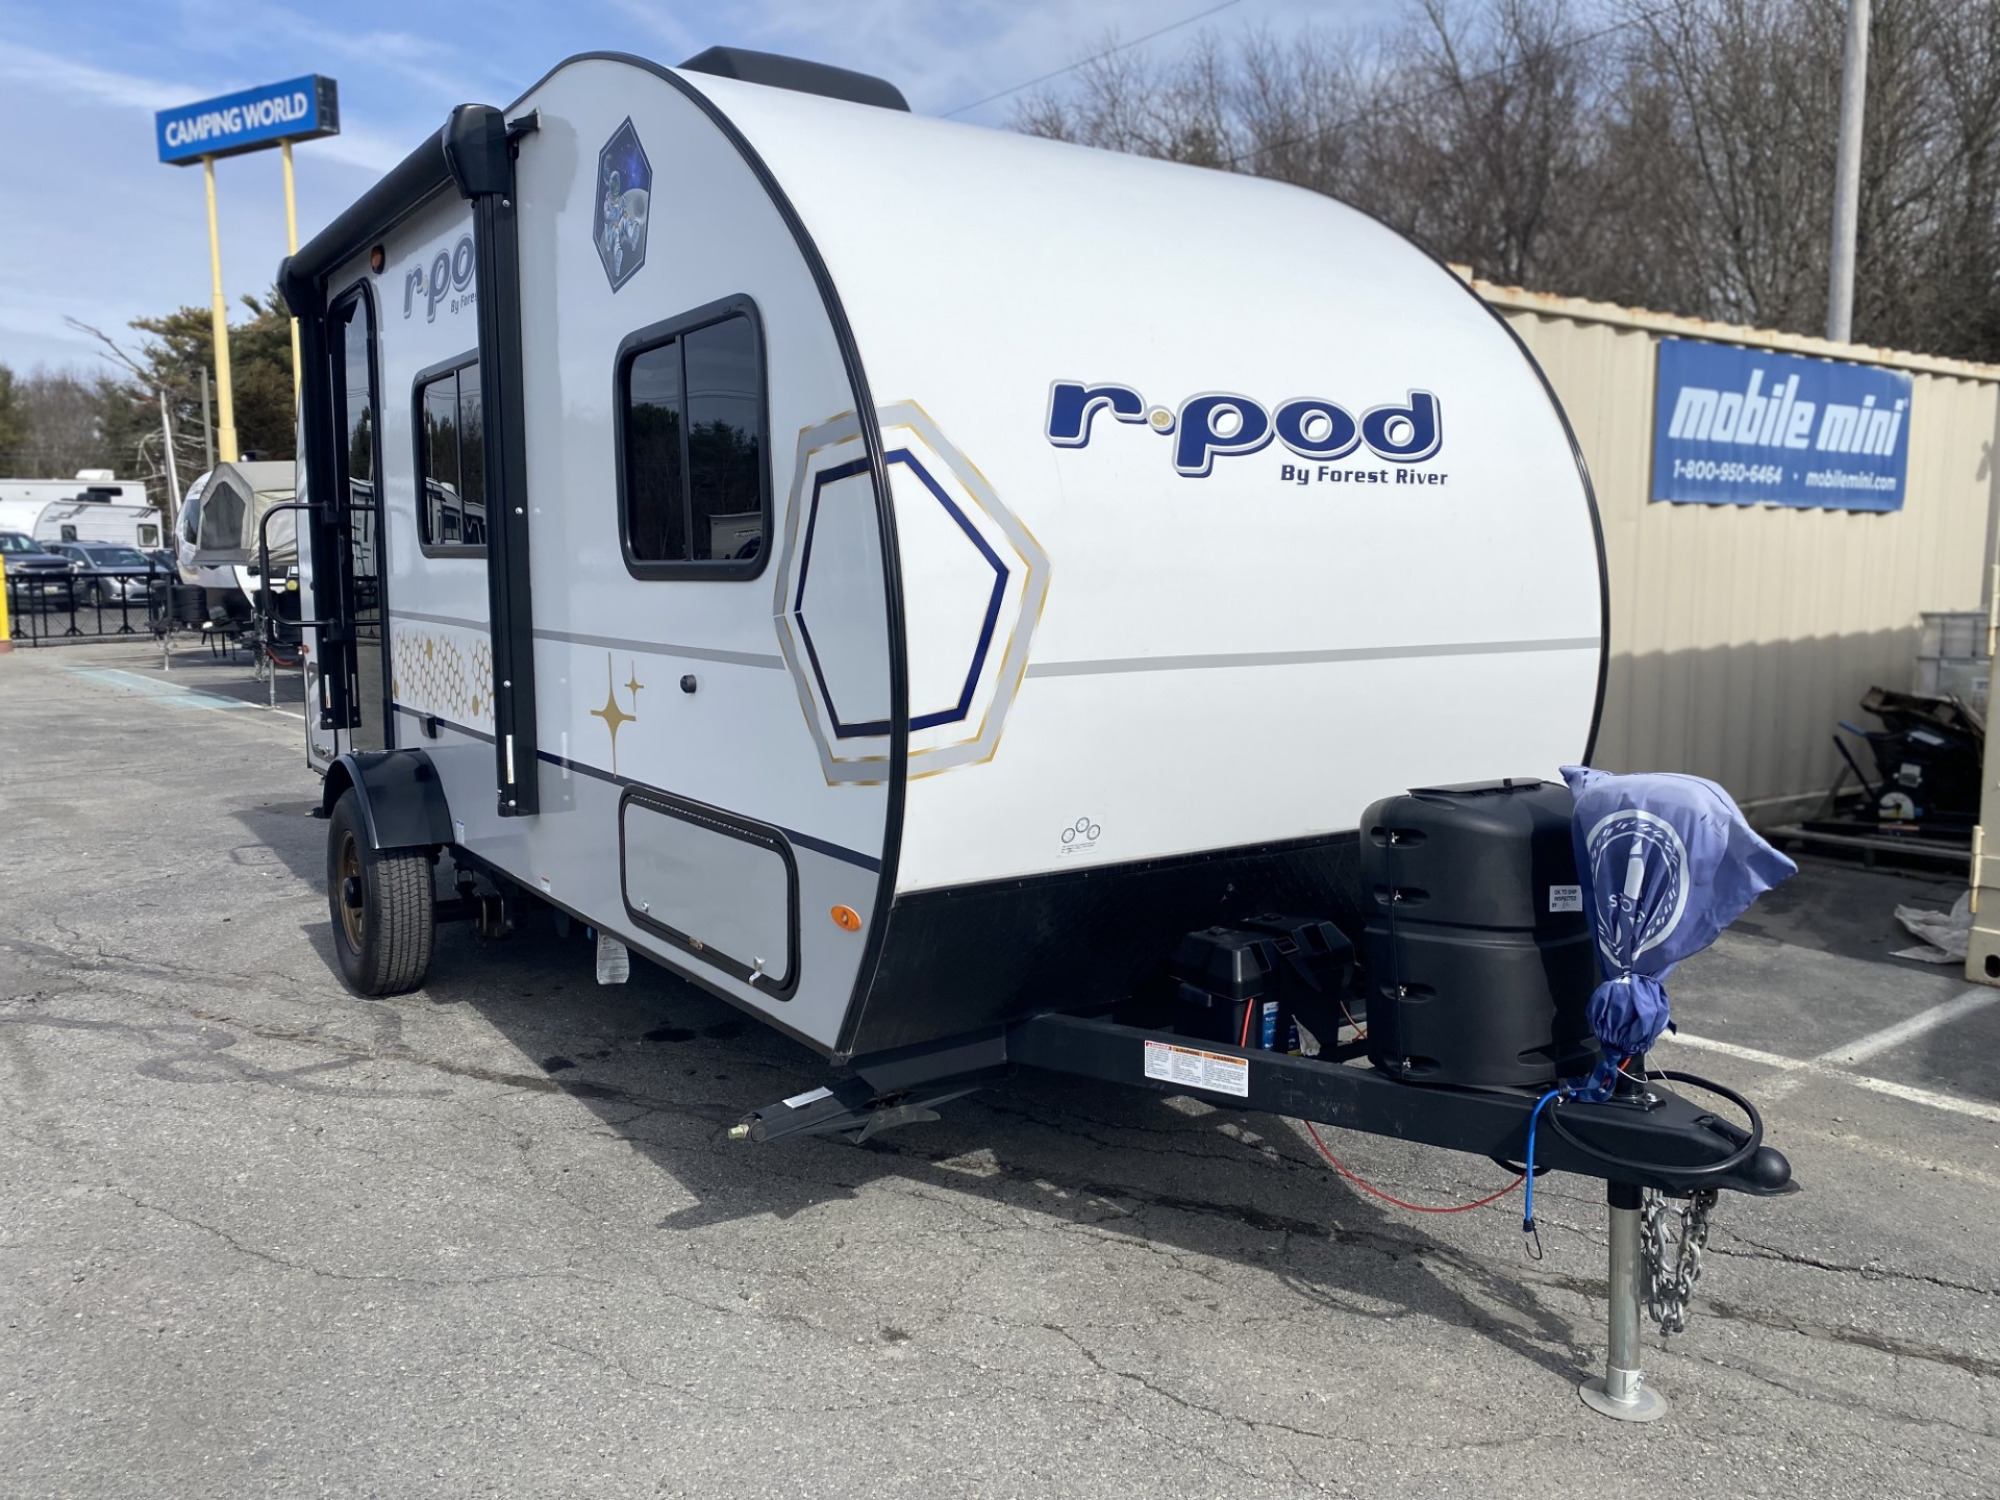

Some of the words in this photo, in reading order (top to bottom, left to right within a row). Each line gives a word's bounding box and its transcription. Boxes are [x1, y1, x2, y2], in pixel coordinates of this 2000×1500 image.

[165, 106, 242, 147] CAMPING
[243, 92, 308, 130] WORLD
[1668, 369, 1816, 450] mobile
[1816, 395, 1902, 457] mini
[1281, 464, 1310, 486] By
[1317, 466, 1389, 484] Forest
[1396, 468, 1448, 486] River
[1673, 459, 1783, 485] 1-800-950-6464
[1805, 469, 1897, 492] mobilemini.com
